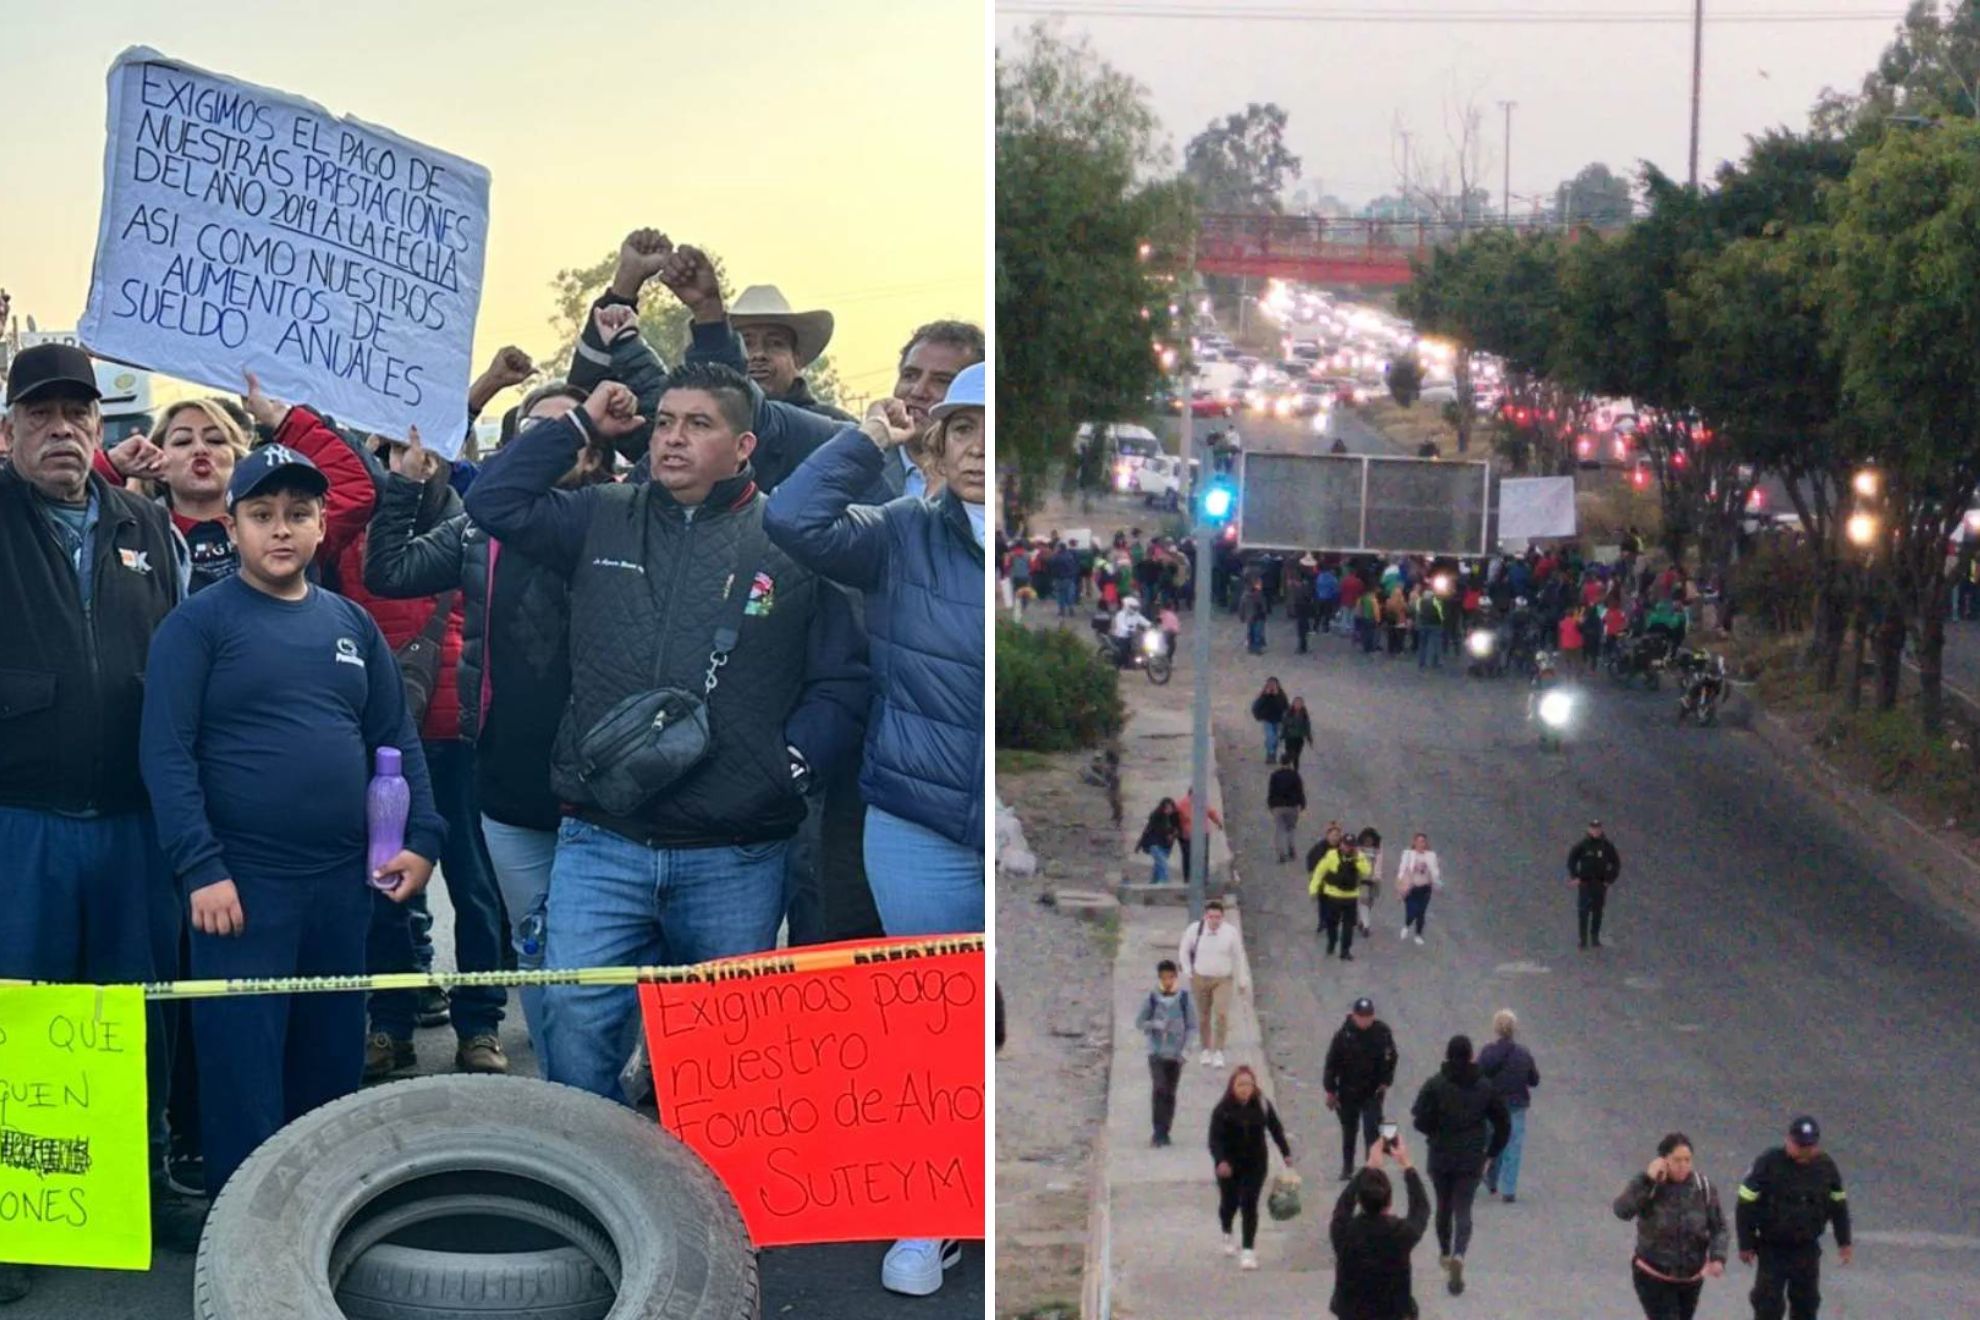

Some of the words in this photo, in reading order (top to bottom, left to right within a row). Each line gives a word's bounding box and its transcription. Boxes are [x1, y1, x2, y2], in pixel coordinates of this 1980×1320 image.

[136, 109, 294, 187] NUESTRAS
[304, 155, 471, 253] PRESTACIONES
[142, 62, 275, 141] EXIGIMOS
[293, 117, 330, 156] EL
[339, 131, 396, 181] PAGO
[409, 158, 445, 203] DE
[121, 203, 179, 248] ASI
[196, 223, 296, 276] COMO
[306, 249, 446, 330] NUESTROS
[134, 146, 198, 197] DEL
[203, 169, 266, 216] AÑO
[269, 189, 318, 233] 2019
[322, 207, 342, 241] A
[348, 214, 376, 256] LA
[382, 226, 459, 292] FECHA
[112, 278, 248, 349] SUELDO
[274, 320, 424, 407] ANUALES
[161, 253, 330, 324] AUMENTOS
[351, 302, 394, 352] DE
[49, 1015, 124, 1052] QUE
[871, 969, 976, 1035] pago
[671, 1024, 868, 1096] nuestro
[672, 1089, 819, 1147] Fondo
[834, 1079, 887, 1127] de
[895, 1069, 984, 1125] Aho
[0, 1187, 87, 1227] ONES
